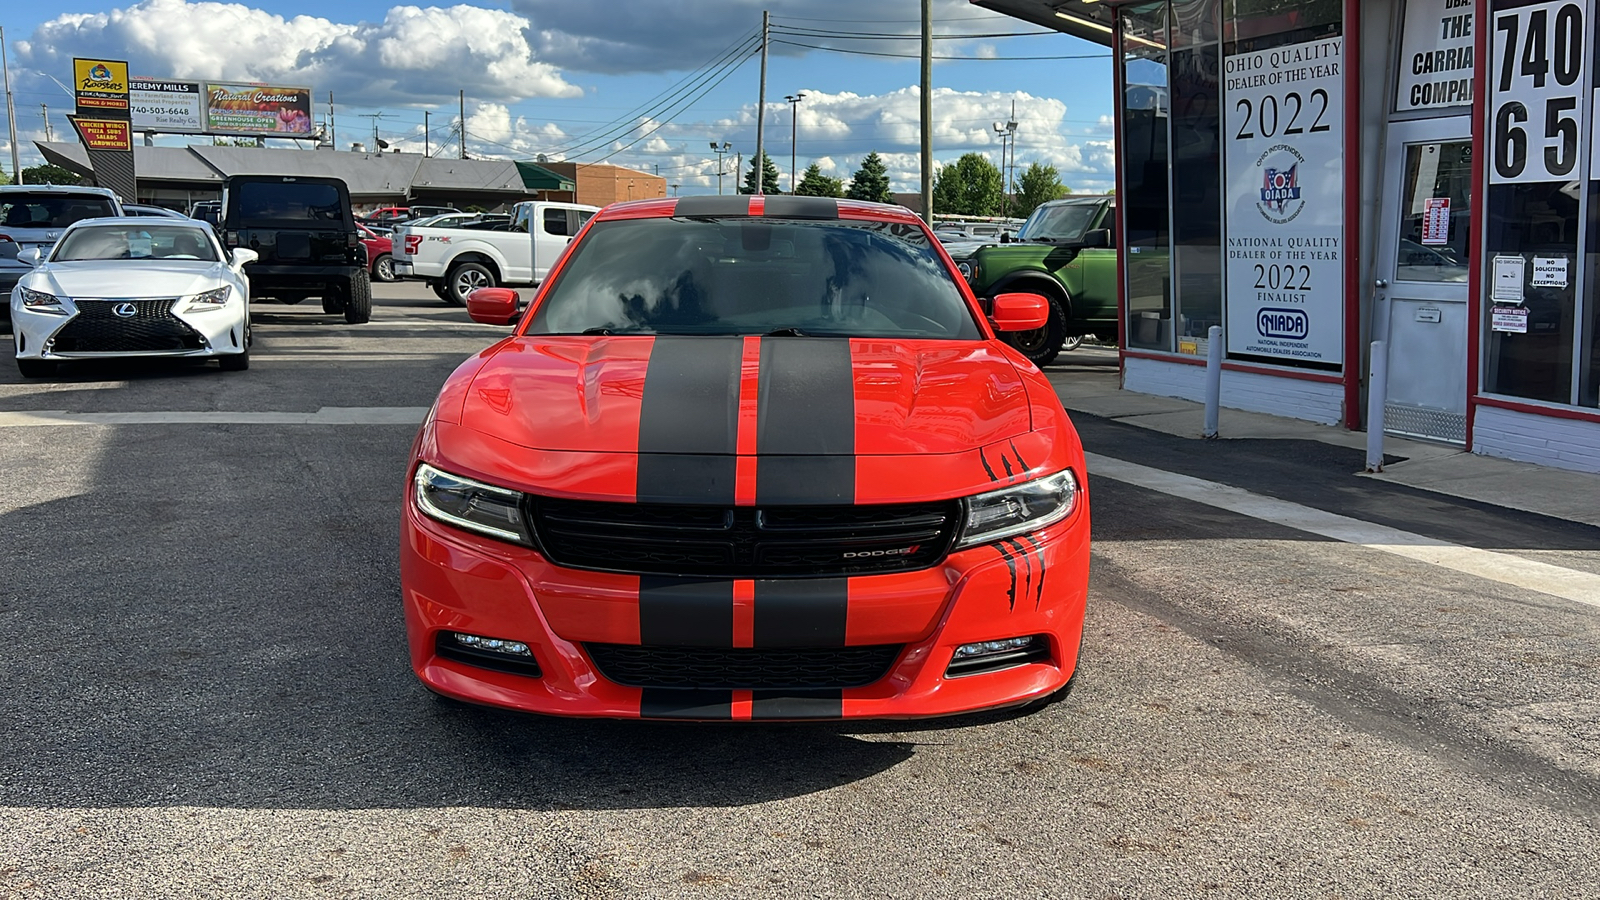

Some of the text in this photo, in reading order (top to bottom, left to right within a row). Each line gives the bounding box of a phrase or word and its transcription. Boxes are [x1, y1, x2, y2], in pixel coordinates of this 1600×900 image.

[1441, 13, 1473, 40] THE
[1497, 3, 1583, 92] 740
[1226, 55, 1263, 73] OHIO
[1270, 41, 1342, 68] QUALITY
[1412, 46, 1474, 76] CARRIA
[1227, 62, 1340, 91] DEALER OF THE YEAR
[81, 78, 123, 91] Roosters
[129, 82, 189, 92] JEREMY MILLS
[213, 89, 298, 104] Natural Creations
[1410, 78, 1475, 106] COMPA
[131, 106, 189, 116] 740-503-6648
[1235, 88, 1331, 140] 2022
[168, 117, 187, 125] Realty
[1256, 144, 1306, 167] OHIO INDEPENDENT
[1265, 188, 1294, 200] OIADA
[1228, 237, 1340, 249] NATIONAL QUALITY
[1229, 250, 1338, 260] DEALER OF THE YEAR
[1253, 264, 1312, 291] 2022
[1257, 292, 1306, 304] FINALIST
[1260, 313, 1304, 334] NIADA
[1257, 339, 1309, 349] NATIONAL INDEPENDENT
[1246, 345, 1322, 358] AUTOMOBILE DEALERS ASSOCIATION
[843, 547, 911, 558] DODGE
